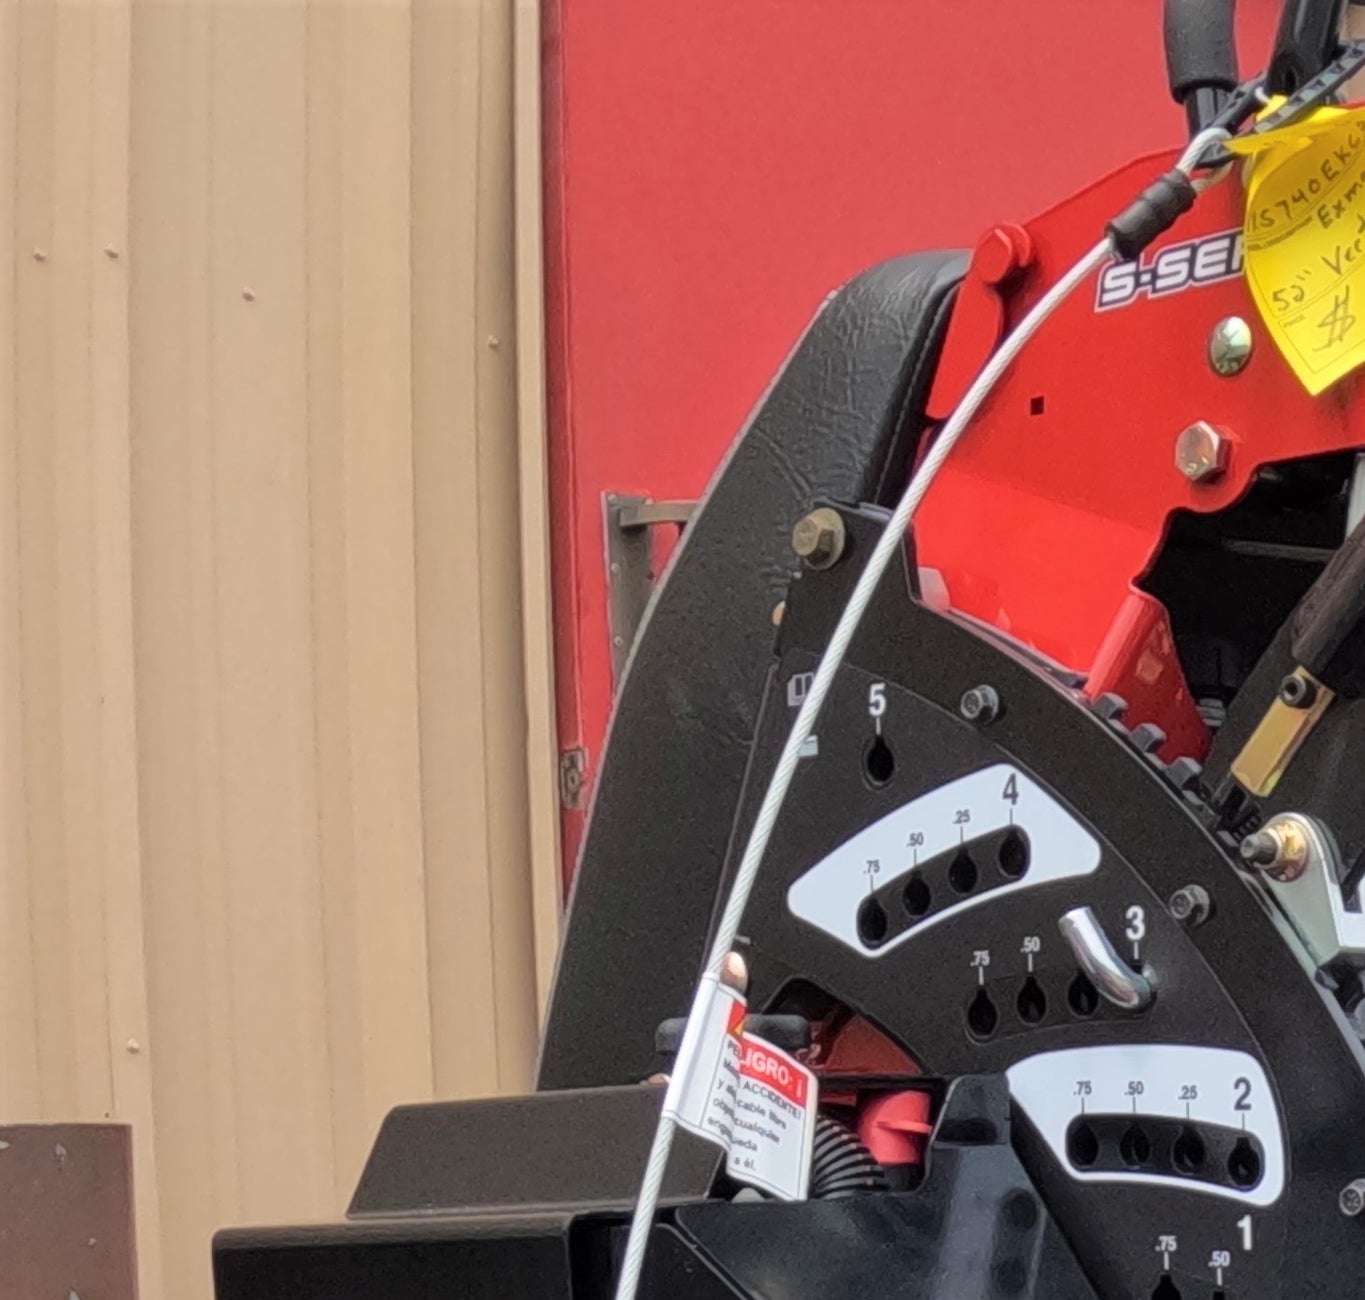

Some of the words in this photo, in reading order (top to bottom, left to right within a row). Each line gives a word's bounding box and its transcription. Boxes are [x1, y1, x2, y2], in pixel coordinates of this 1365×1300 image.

[867, 682, 887, 717] 5
[862, 858, 880, 875] .75
[906, 831, 925, 847] .50
[953, 809, 971, 824] .25
[1002, 773, 1019, 805] 4
[969, 949, 990, 967] .75
[1020, 936, 1040, 953] .50
[1126, 905, 1146, 941] 3
[1072, 1080, 1093, 1096] .75
[1123, 1080, 1145, 1096] .50
[1177, 1085, 1198, 1101] .25
[1232, 1076, 1253, 1111] 2
[1236, 1214, 1253, 1251] 1
[1155, 1235, 1177, 1252] .75
[1208, 1250, 1231, 1267] .50
